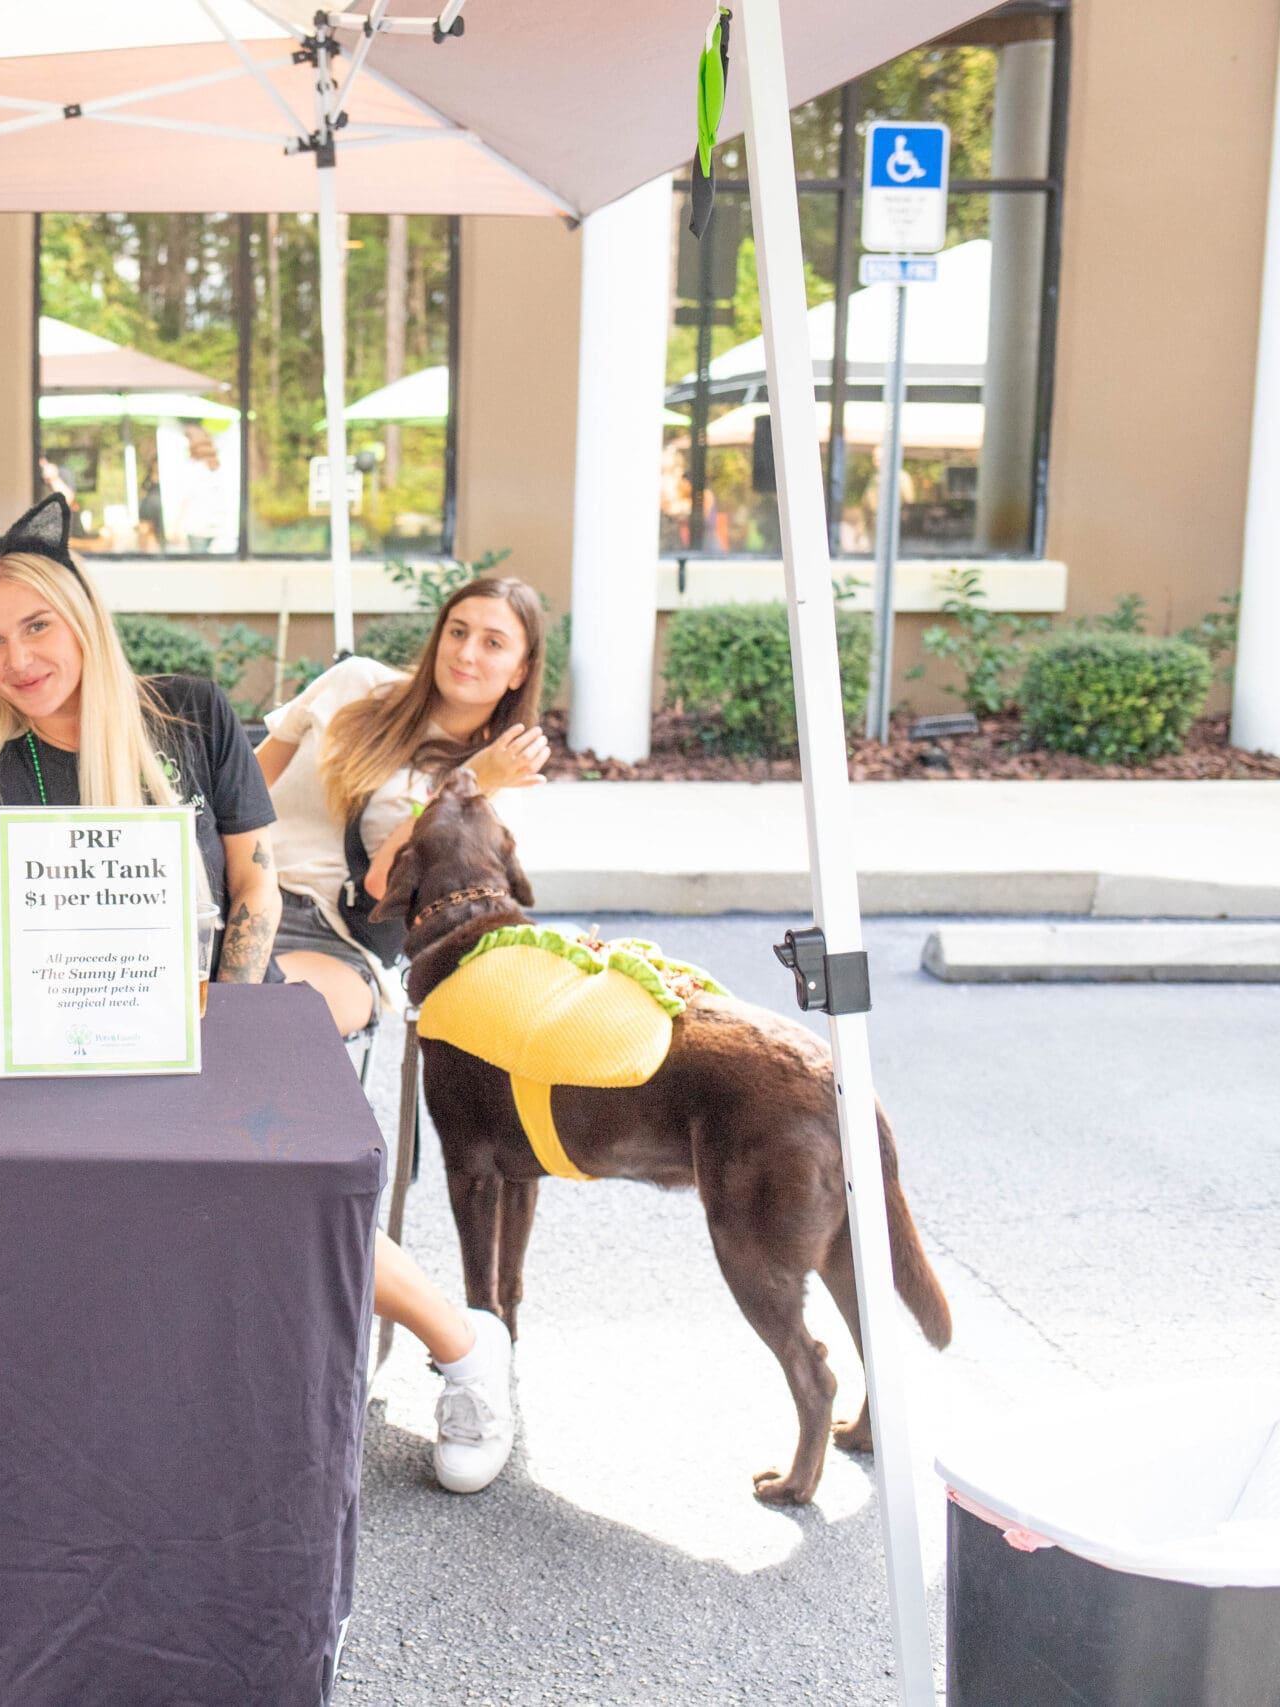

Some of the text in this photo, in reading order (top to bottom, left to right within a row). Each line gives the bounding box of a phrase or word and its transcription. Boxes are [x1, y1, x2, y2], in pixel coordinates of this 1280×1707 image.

[69, 829, 121, 848] PRF
[25, 857, 167, 880] Dunk Tank
[25, 888, 166, 910] $1 per throw!
[46, 953, 150, 965] All proceeds go to
[68, 968, 116, 982] Sunny
[47, 983, 149, 996] to support pets in
[56, 997, 139, 1010] surgical need.
